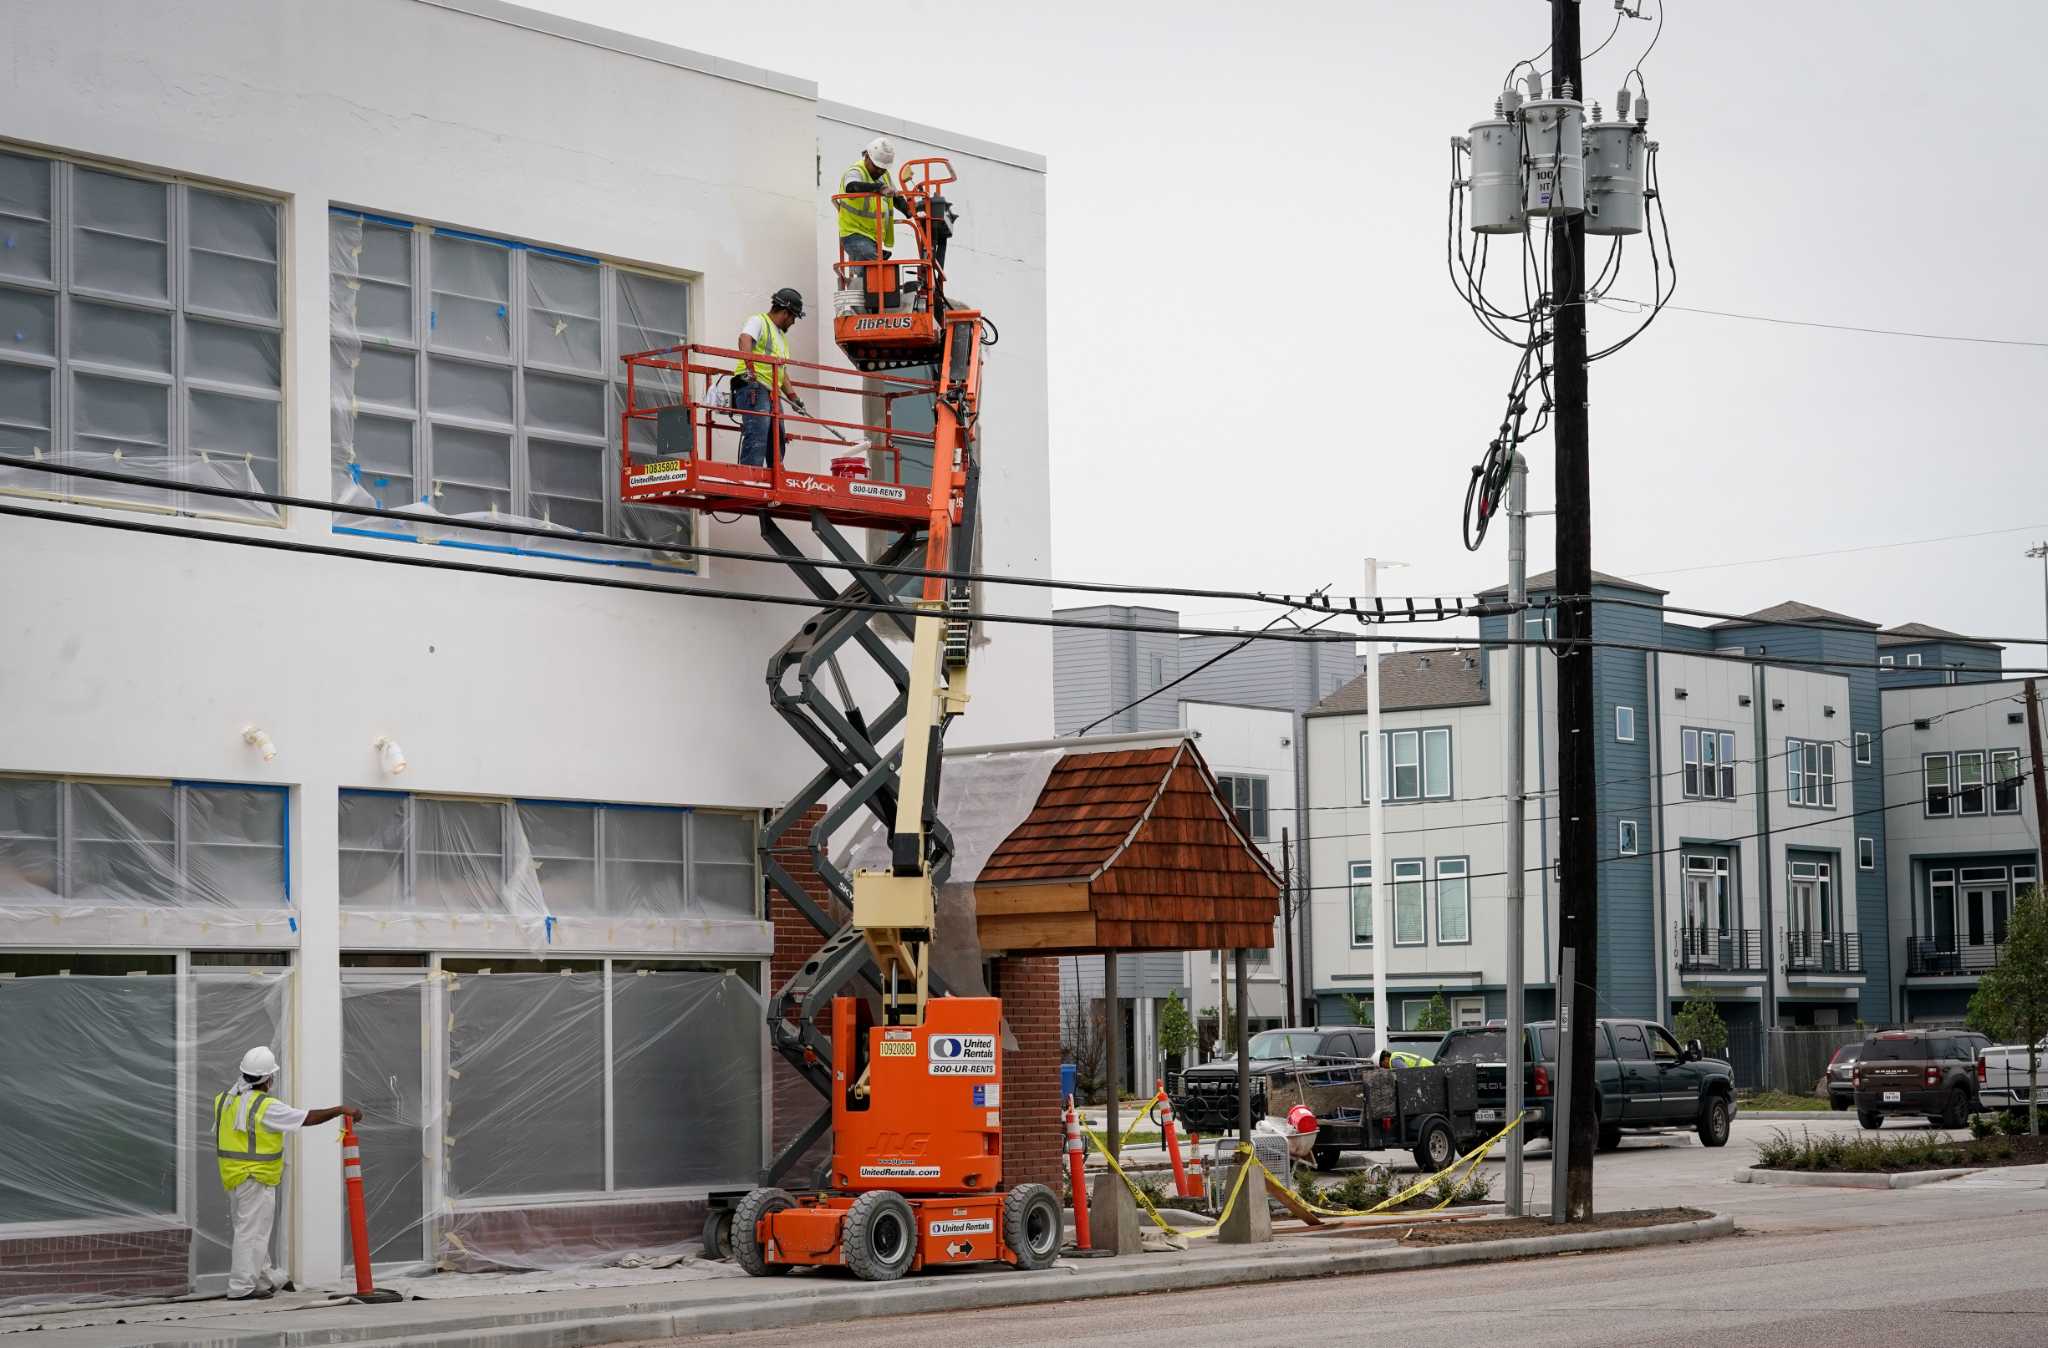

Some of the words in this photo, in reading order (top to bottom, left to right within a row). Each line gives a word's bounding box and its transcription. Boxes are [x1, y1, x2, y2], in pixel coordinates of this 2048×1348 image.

[855, 317, 912, 330] JibPLUS
[645, 461, 679, 475] 10835802
[630, 472, 687, 485] UnitedRentals.com
[852, 484, 904, 499] 800-UR-RENTS
[880, 1042, 915, 1056] 10920880
[963, 1039, 992, 1048] United
[963, 1049, 993, 1058] Rentals
[933, 1065, 994, 1073] 800-UR-RENTS
[861, 1169, 939, 1177] UnitedRentals.com
[942, 1223, 965, 1233] United
[965, 1221, 990, 1231] Rentals
